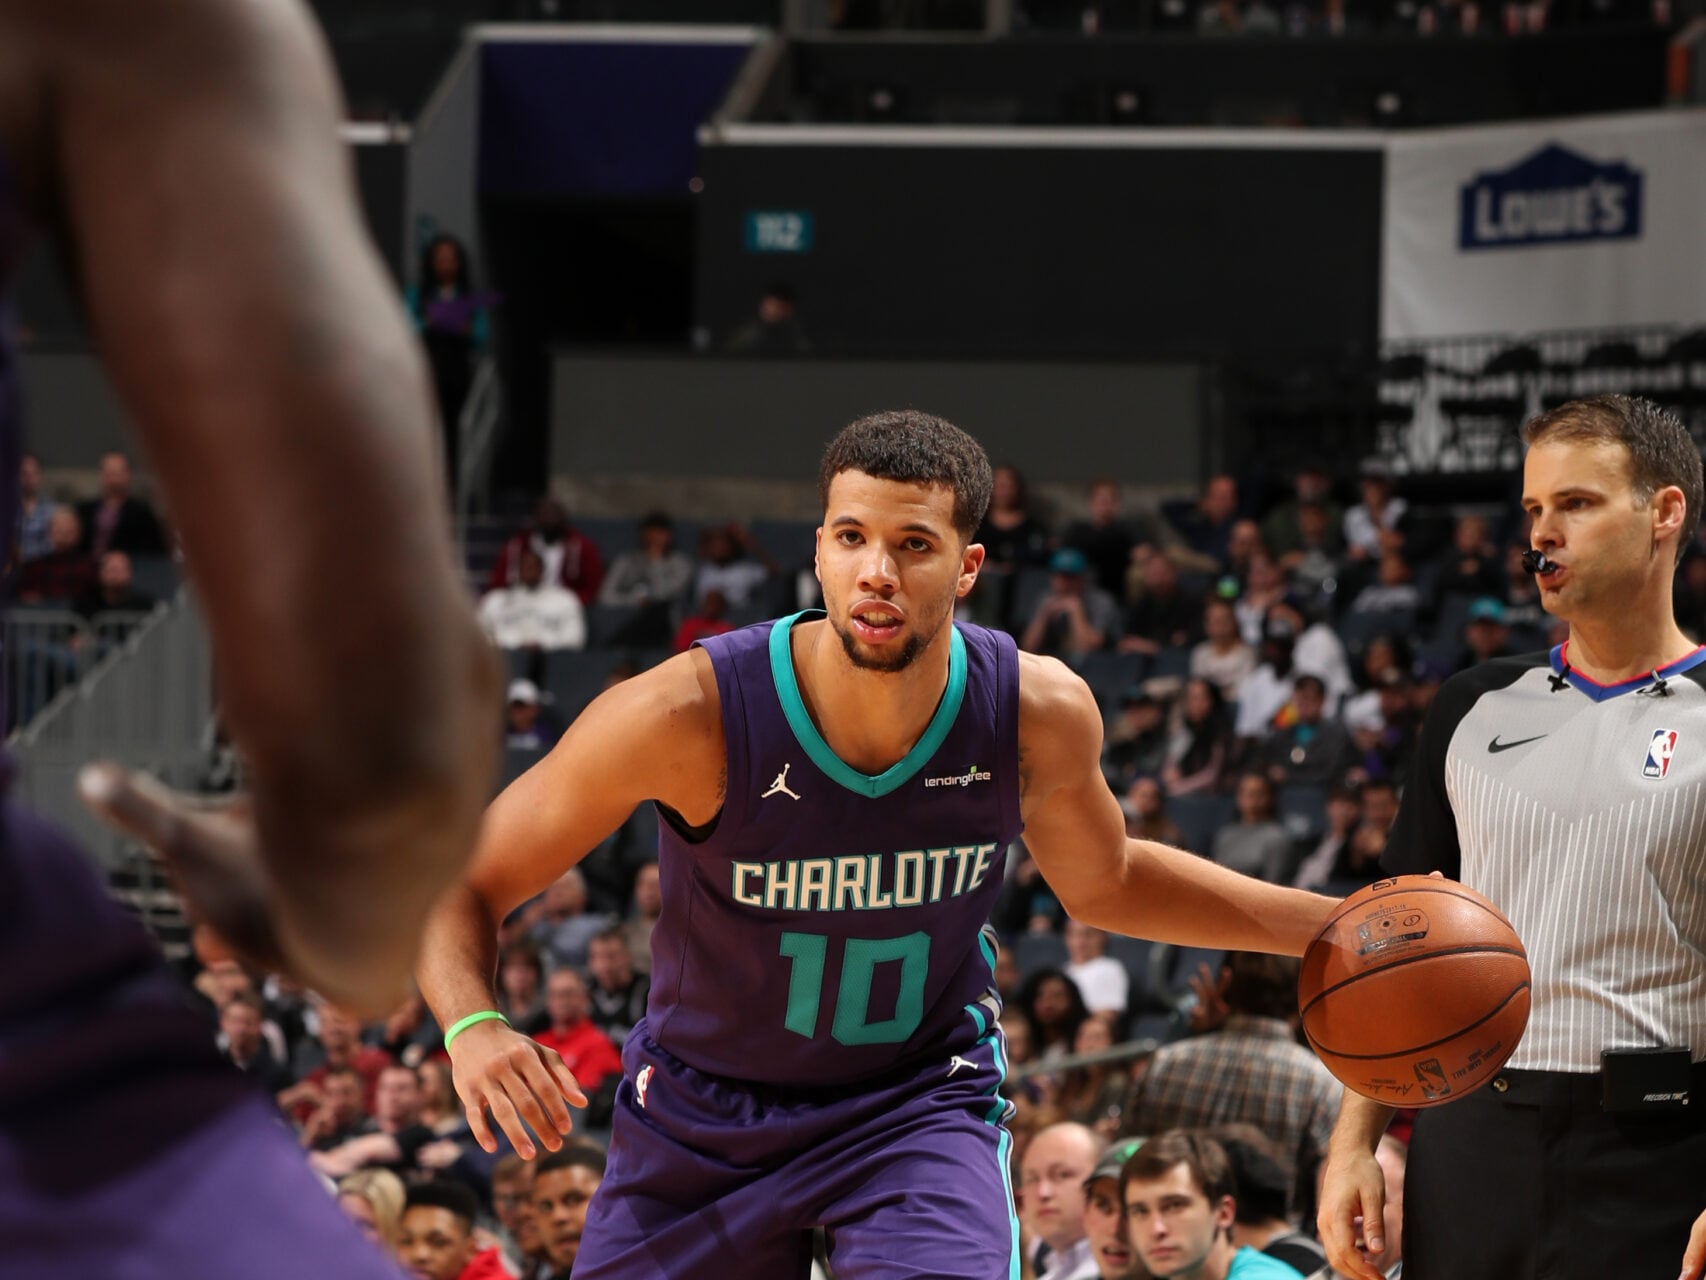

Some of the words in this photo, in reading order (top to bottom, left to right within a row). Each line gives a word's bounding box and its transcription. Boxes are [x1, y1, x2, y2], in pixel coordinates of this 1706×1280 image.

[756, 213, 804, 250] 112
[1475, 178, 1627, 240] LOWE'S
[924, 767, 992, 788] lendingtree
[731, 842, 998, 912] CHARLOTTE
[778, 930, 932, 1047] 10
